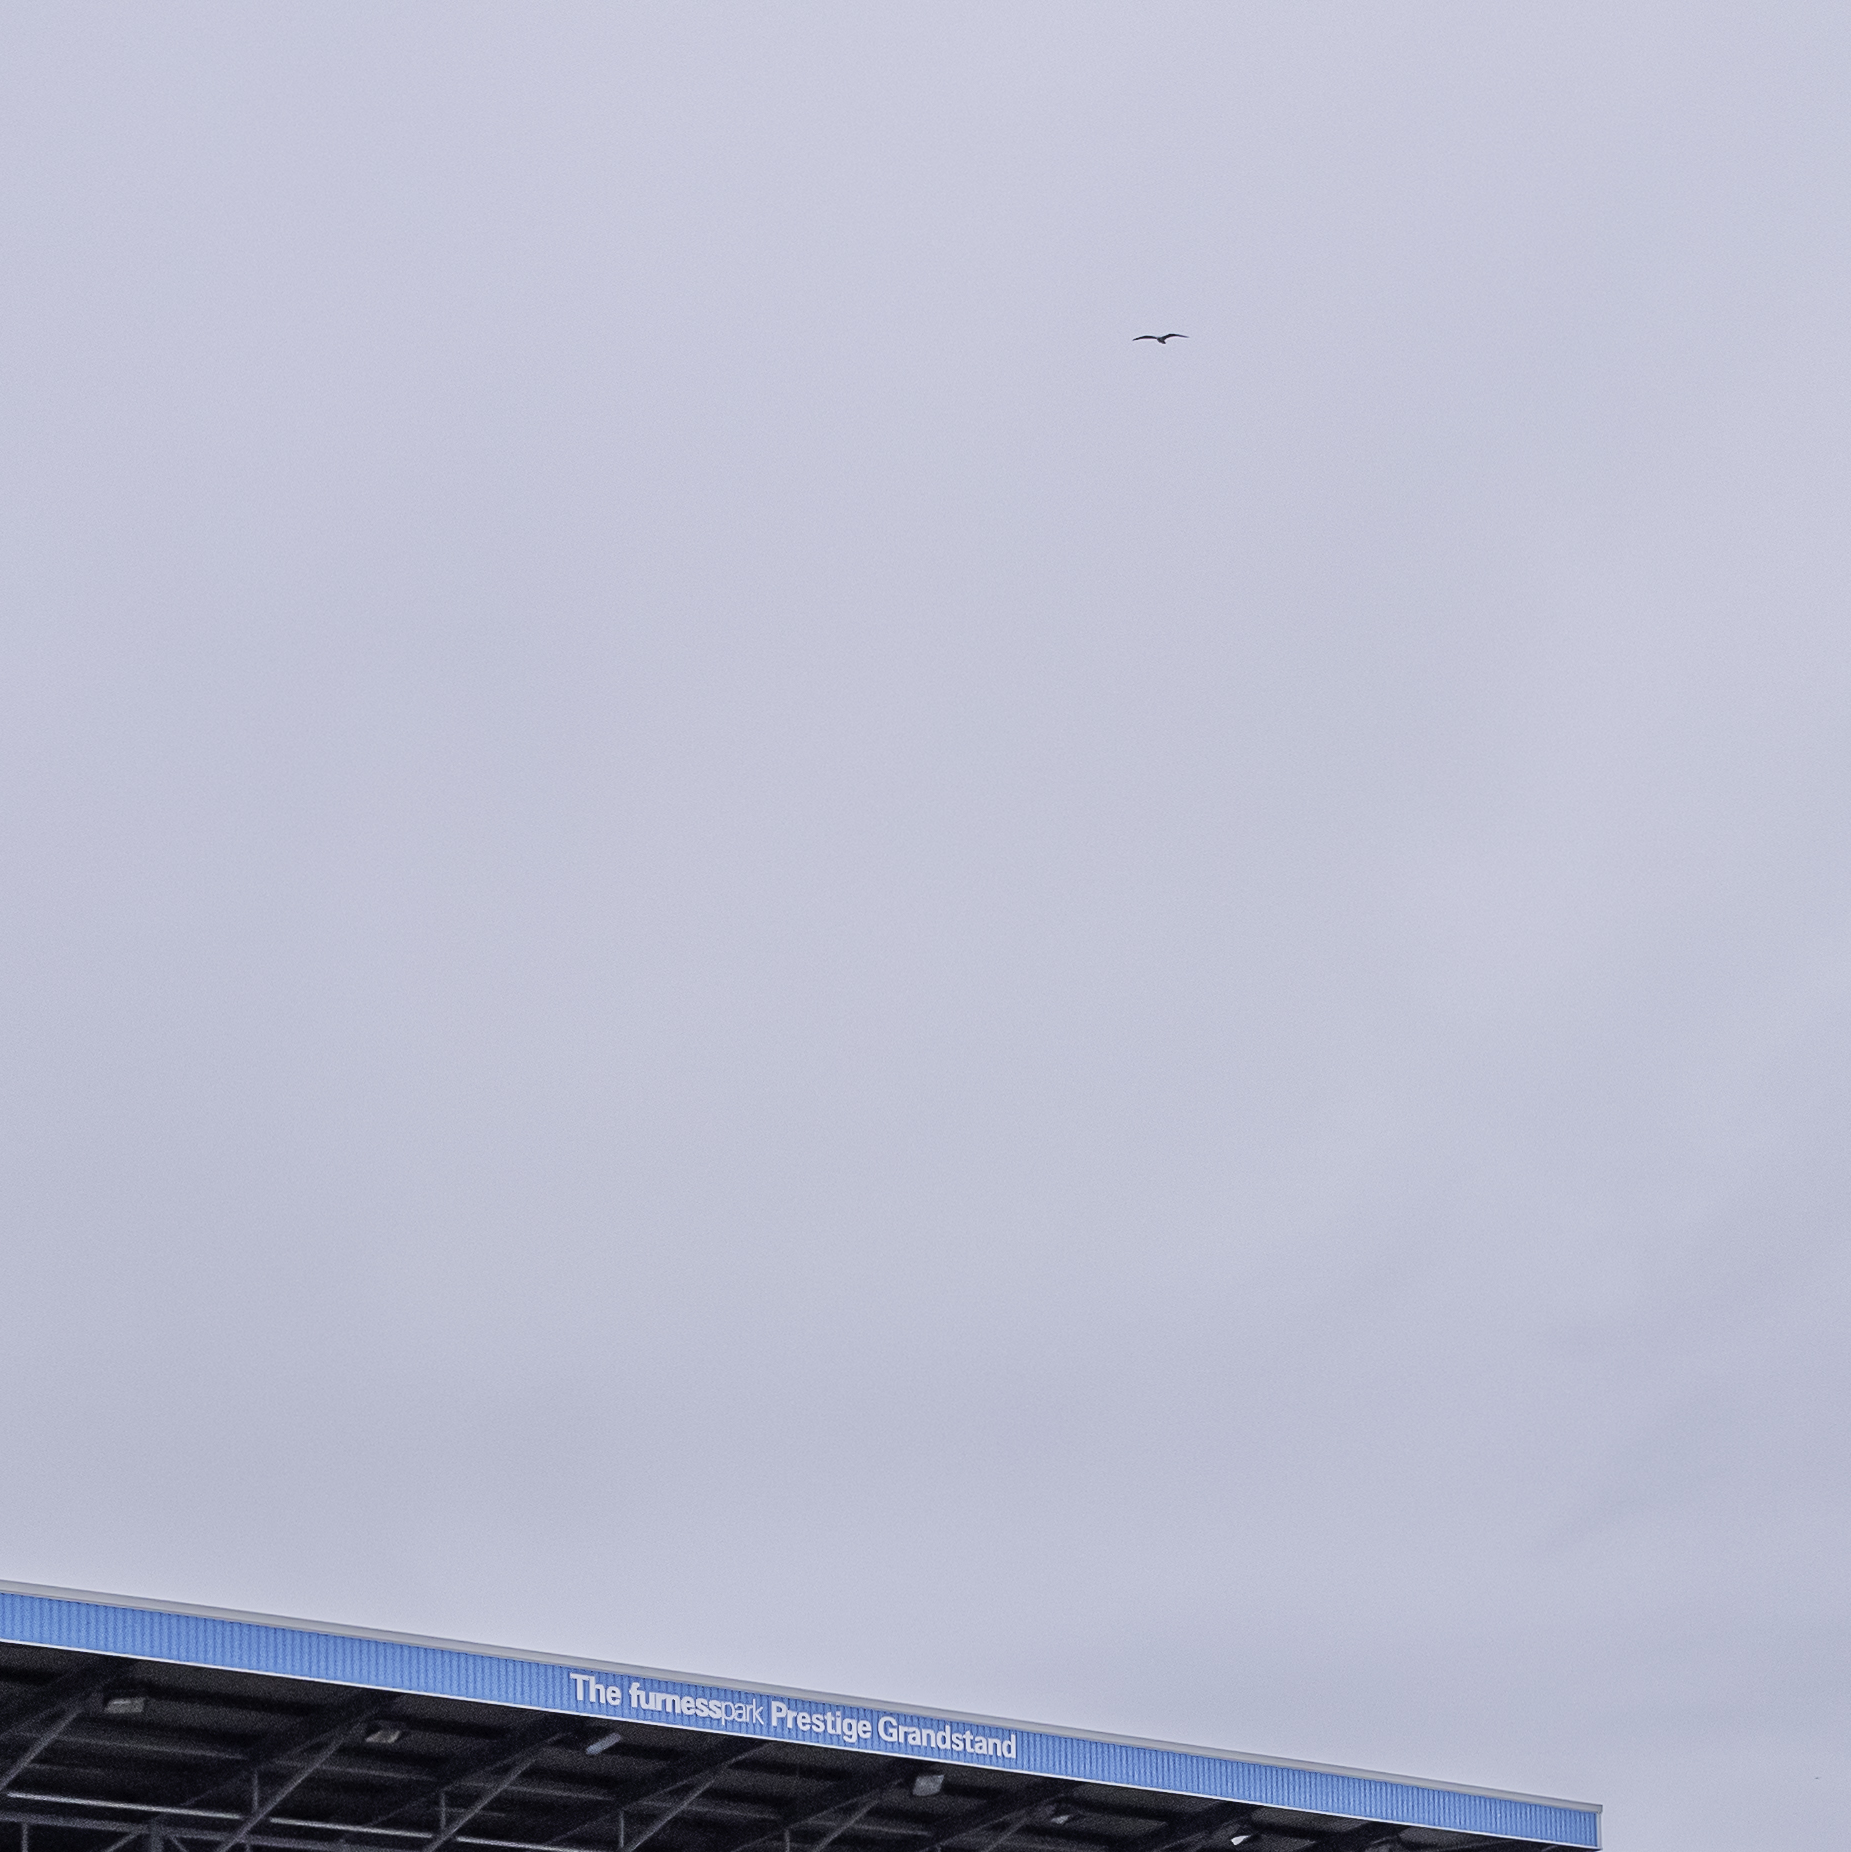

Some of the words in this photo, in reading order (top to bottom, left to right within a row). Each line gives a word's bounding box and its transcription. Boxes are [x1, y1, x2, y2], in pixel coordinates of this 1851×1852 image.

[570, 1672, 621, 1705] The
[629, 1682, 764, 1725] furnesspark
[771, 1701, 872, 1743] Prestige
[878, 1716, 1016, 1759] Grandstand
